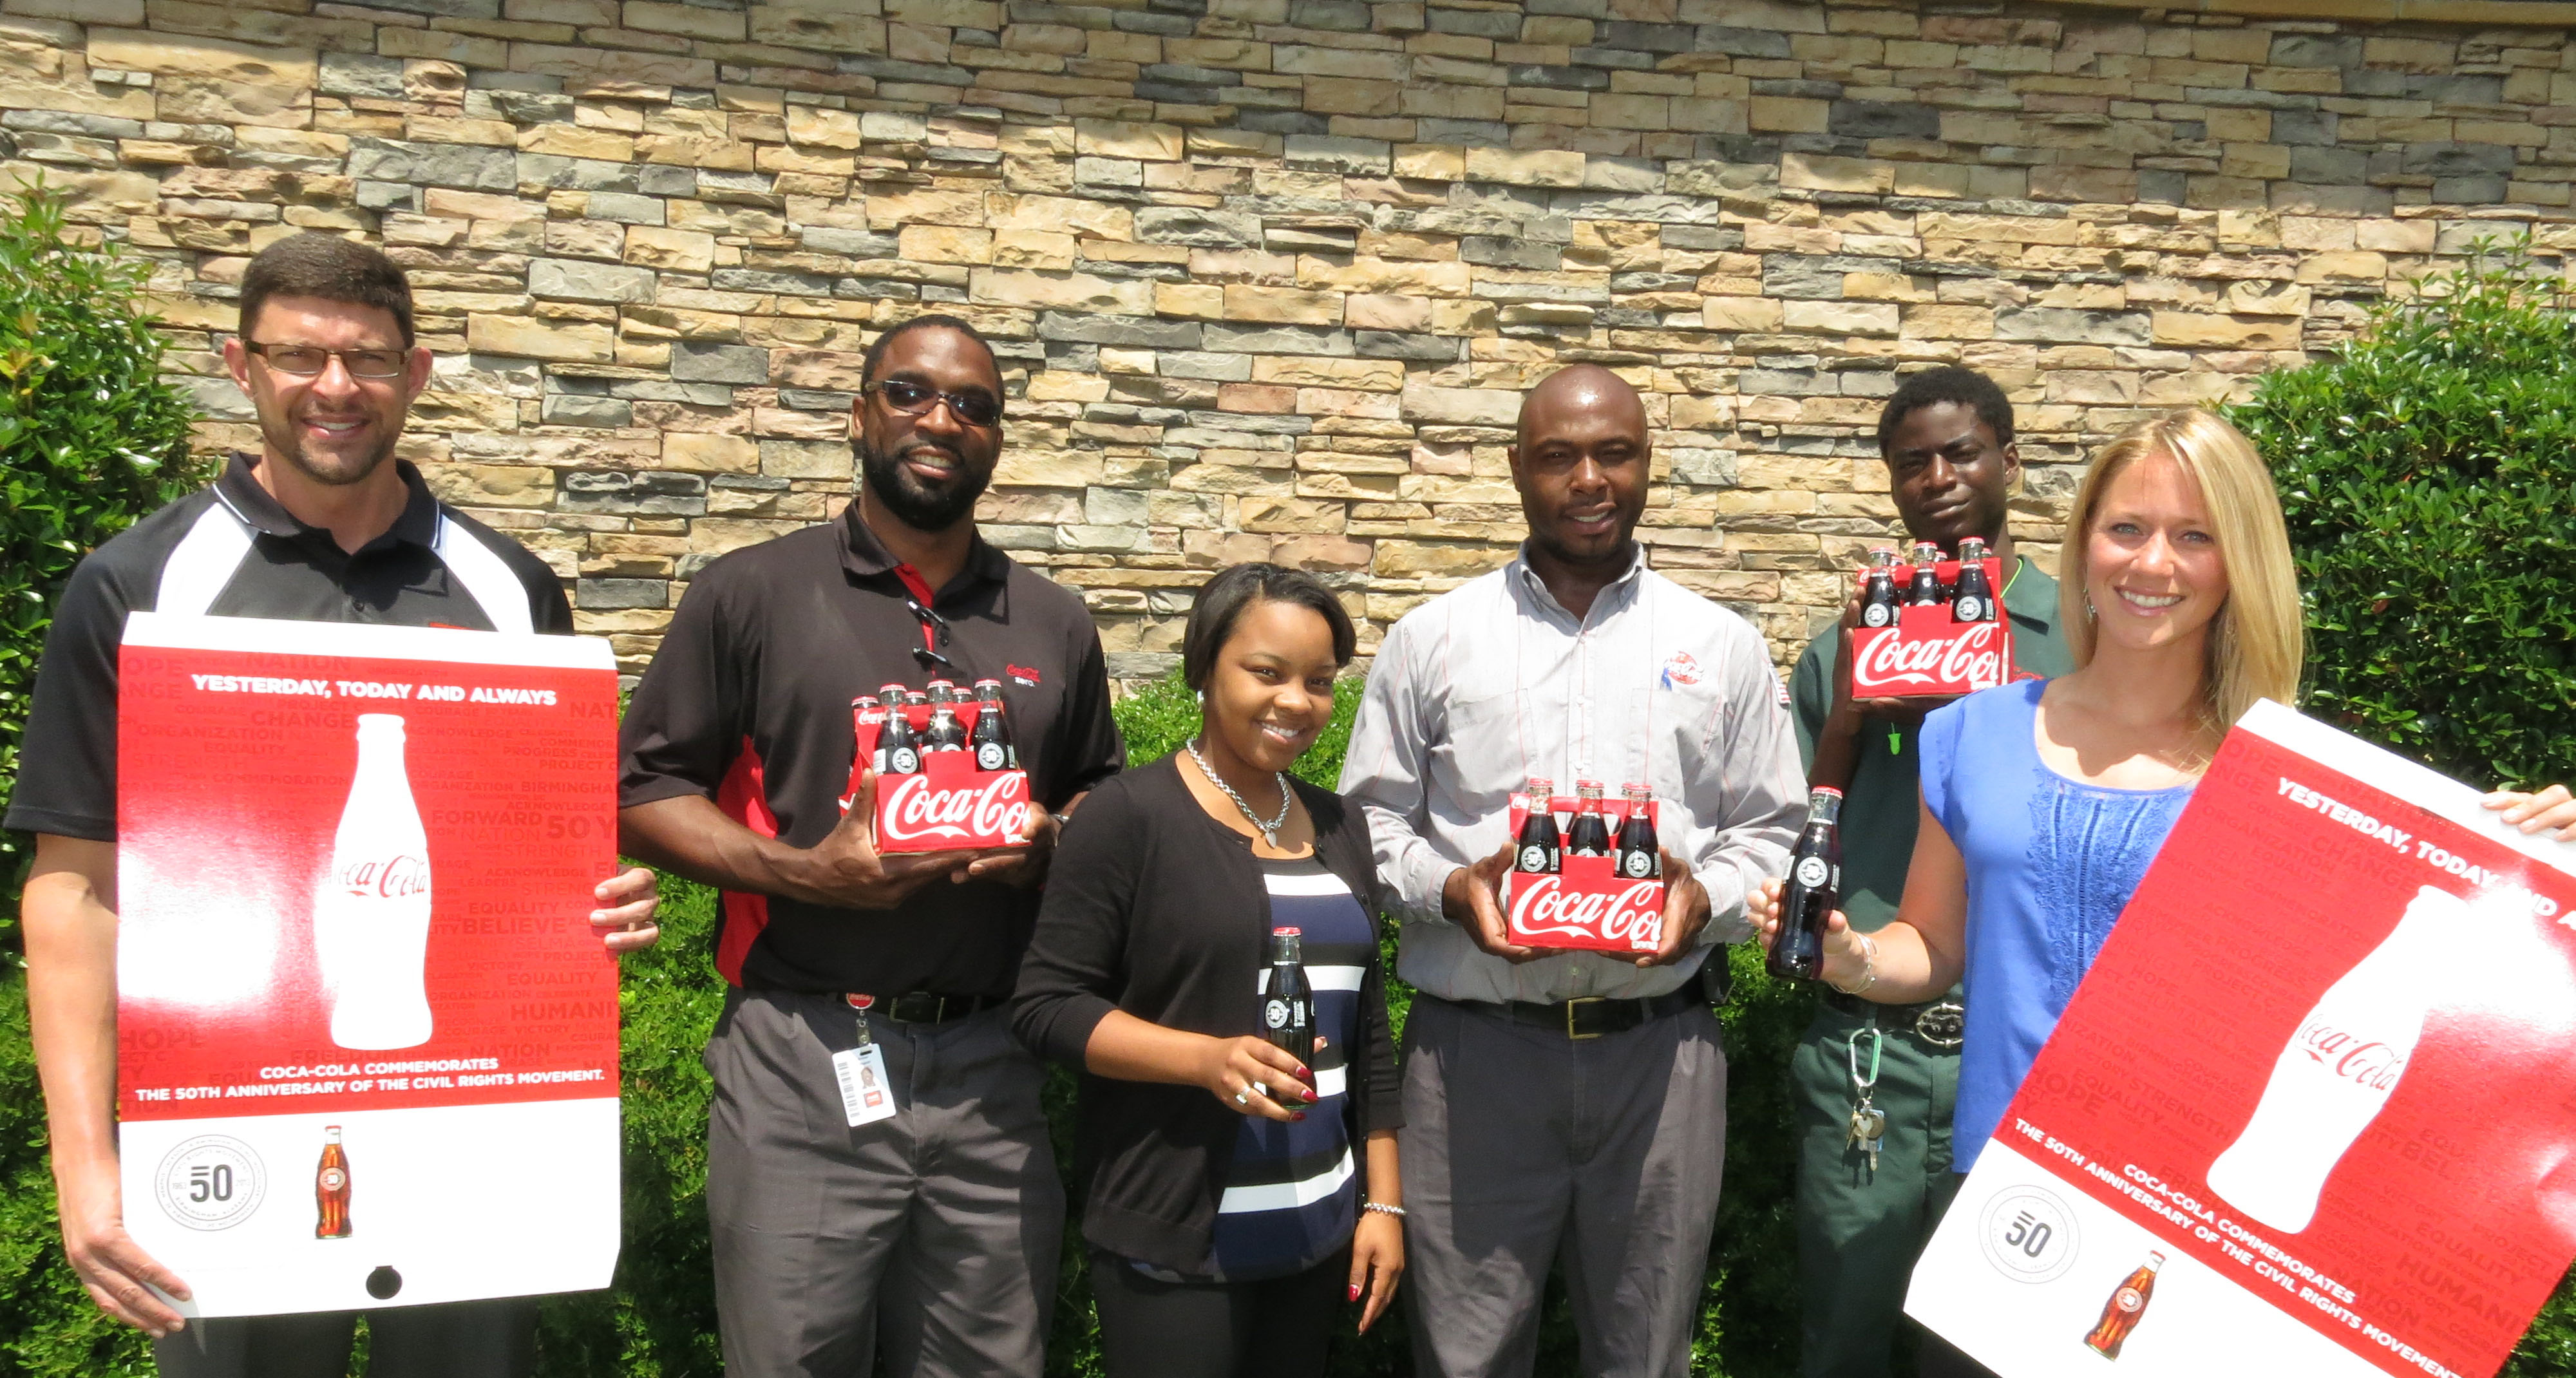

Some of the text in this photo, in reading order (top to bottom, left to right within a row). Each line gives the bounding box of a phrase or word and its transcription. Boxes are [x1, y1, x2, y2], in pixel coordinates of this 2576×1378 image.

[191, 674, 557, 706] YESTERDAY, TODAY AND ALWAYS
[137, 724, 283, 740] ORGANIZATION
[251, 711, 354, 729] CHANGE
[503, 746, 578, 757] PROGRESS
[539, 759, 605, 771] PROJECT
[506, 802, 608, 813] ACKNOWLEDGE
[431, 809, 543, 826] FORWARD
[547, 815, 591, 839] 50
[2199, 803, 2339, 876] ORGANIZATION
[2278, 777, 2412, 854] YESTERDAY,
[2416, 840, 2501, 888] TODAY
[502, 844, 602, 858] STRENGTH
[2307, 831, 2423, 896] CHANGE
[336, 855, 426, 898] oca-Cola
[468, 902, 559, 914] EQUALITY
[463, 917, 567, 934] BELIEVE
[507, 972, 599, 986] EQUALITY
[2129, 963, 2181, 999] HOPE
[511, 1001, 612, 1021] HUMANI
[470, 1043, 551, 1057] NATION
[259, 1057, 499, 1079] COCA-COLA COMMEMORATES
[135, 1069, 605, 1101] THE 50TH ANNIVERSARY OF THE CIVIL RIGHTS MOVEMENT.
[2070, 1065, 2165, 1130] EQUALITY
[2126, 1073, 2234, 1145] STRENGTH
[190, 1164, 232, 1203] 50
[2005, 1218, 2052, 1258] 50
[2016, 1118, 2045, 1143] THE
[2044, 1137, 2085, 1166] 50TH
[2084, 1162, 2195, 1229] ANNIVERSARY
[2194, 1225, 2221, 1243] OF
[2221, 1239, 2255, 1266] THE
[2254, 1261, 2296, 1293] CIVIL
[2298, 1286, 2362, 1329] RIGHTS
[2124, 1163, 2215, 1221] COCA-COLA
[2217, 1218, 2356, 1304] COMMEMORATES
[2413, 1218, 2526, 1292] EQUALITY
[2327, 1262, 2423, 1330] NATION
[2394, 1249, 2523, 1337] HUMANI
